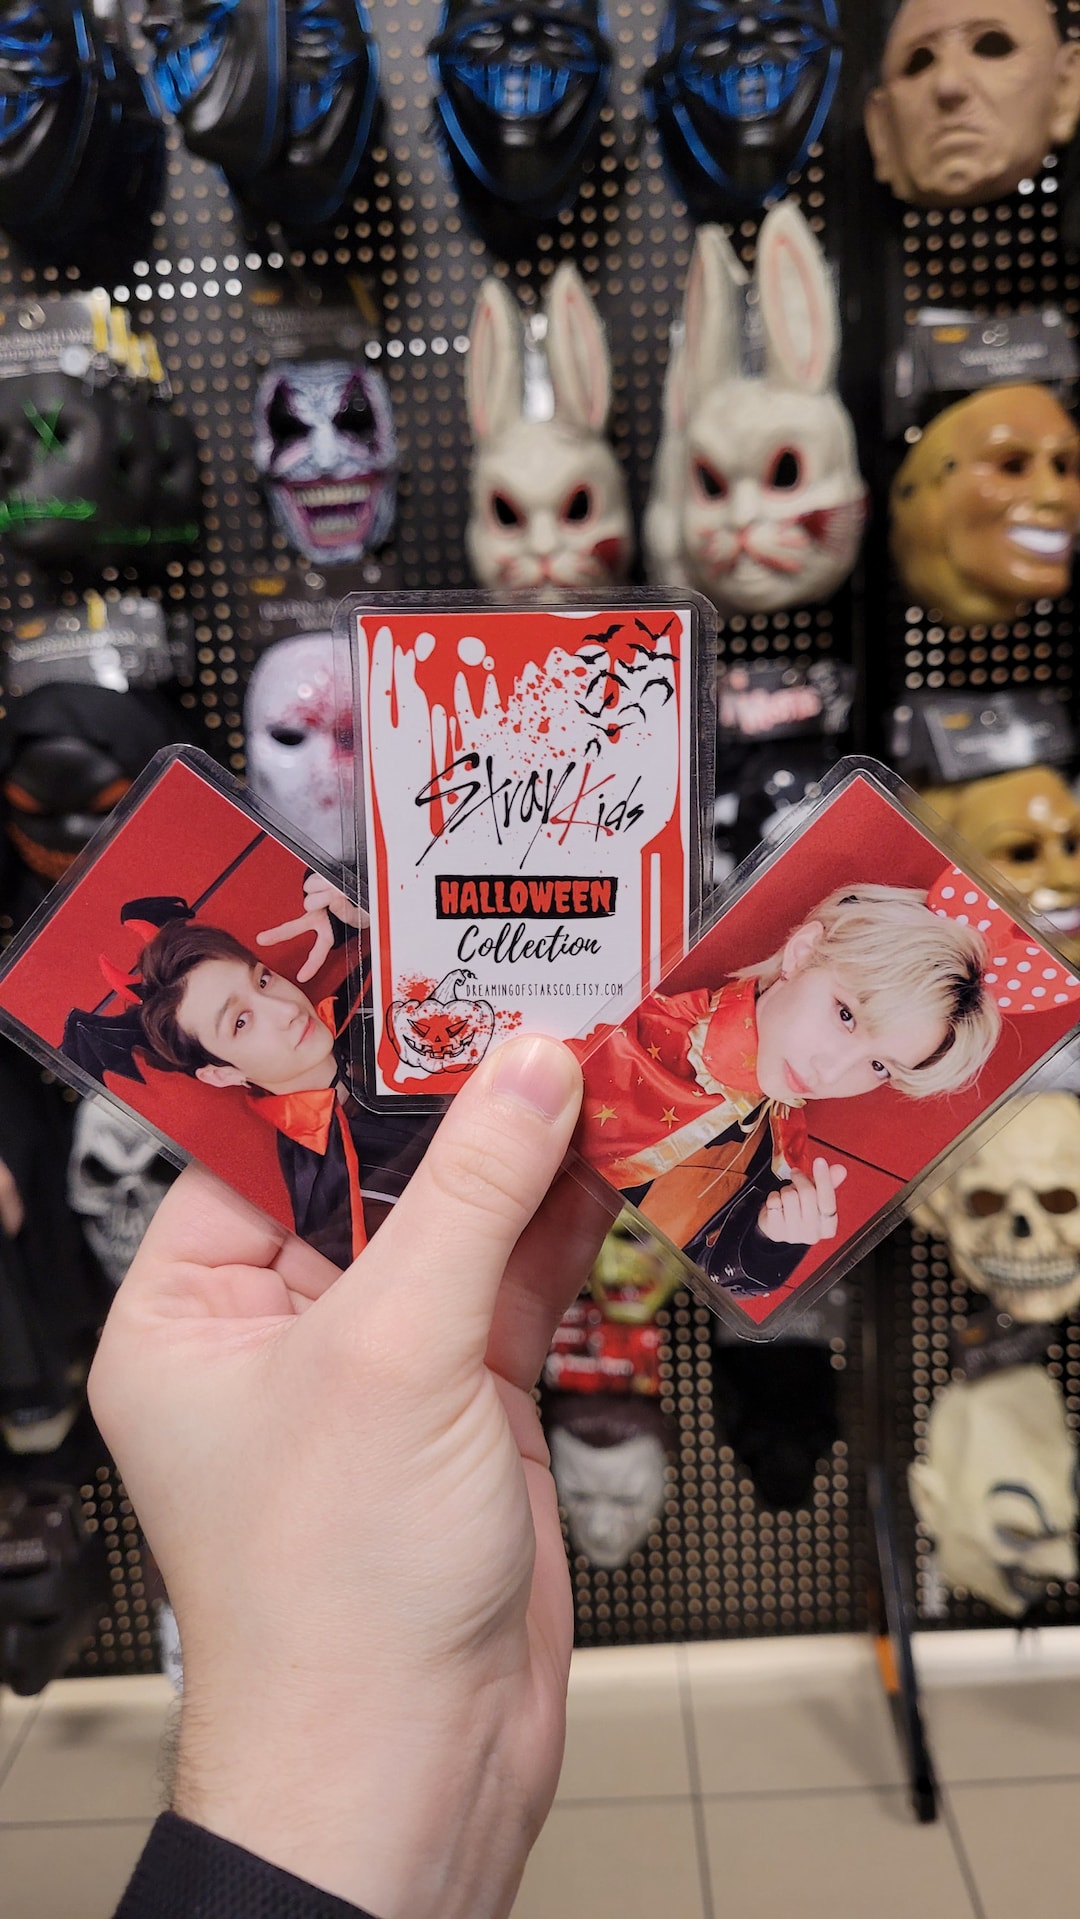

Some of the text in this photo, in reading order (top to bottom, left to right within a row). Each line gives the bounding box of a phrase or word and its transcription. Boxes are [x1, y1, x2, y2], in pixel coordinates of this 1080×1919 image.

[415, 752, 644, 869] Stray Kids
[440, 880, 612, 914] HALLOWEEN
[457, 922, 602, 964] Collection
[466, 983, 624, 997] DREAMINGOFSTARSCO.ETSY.COM
